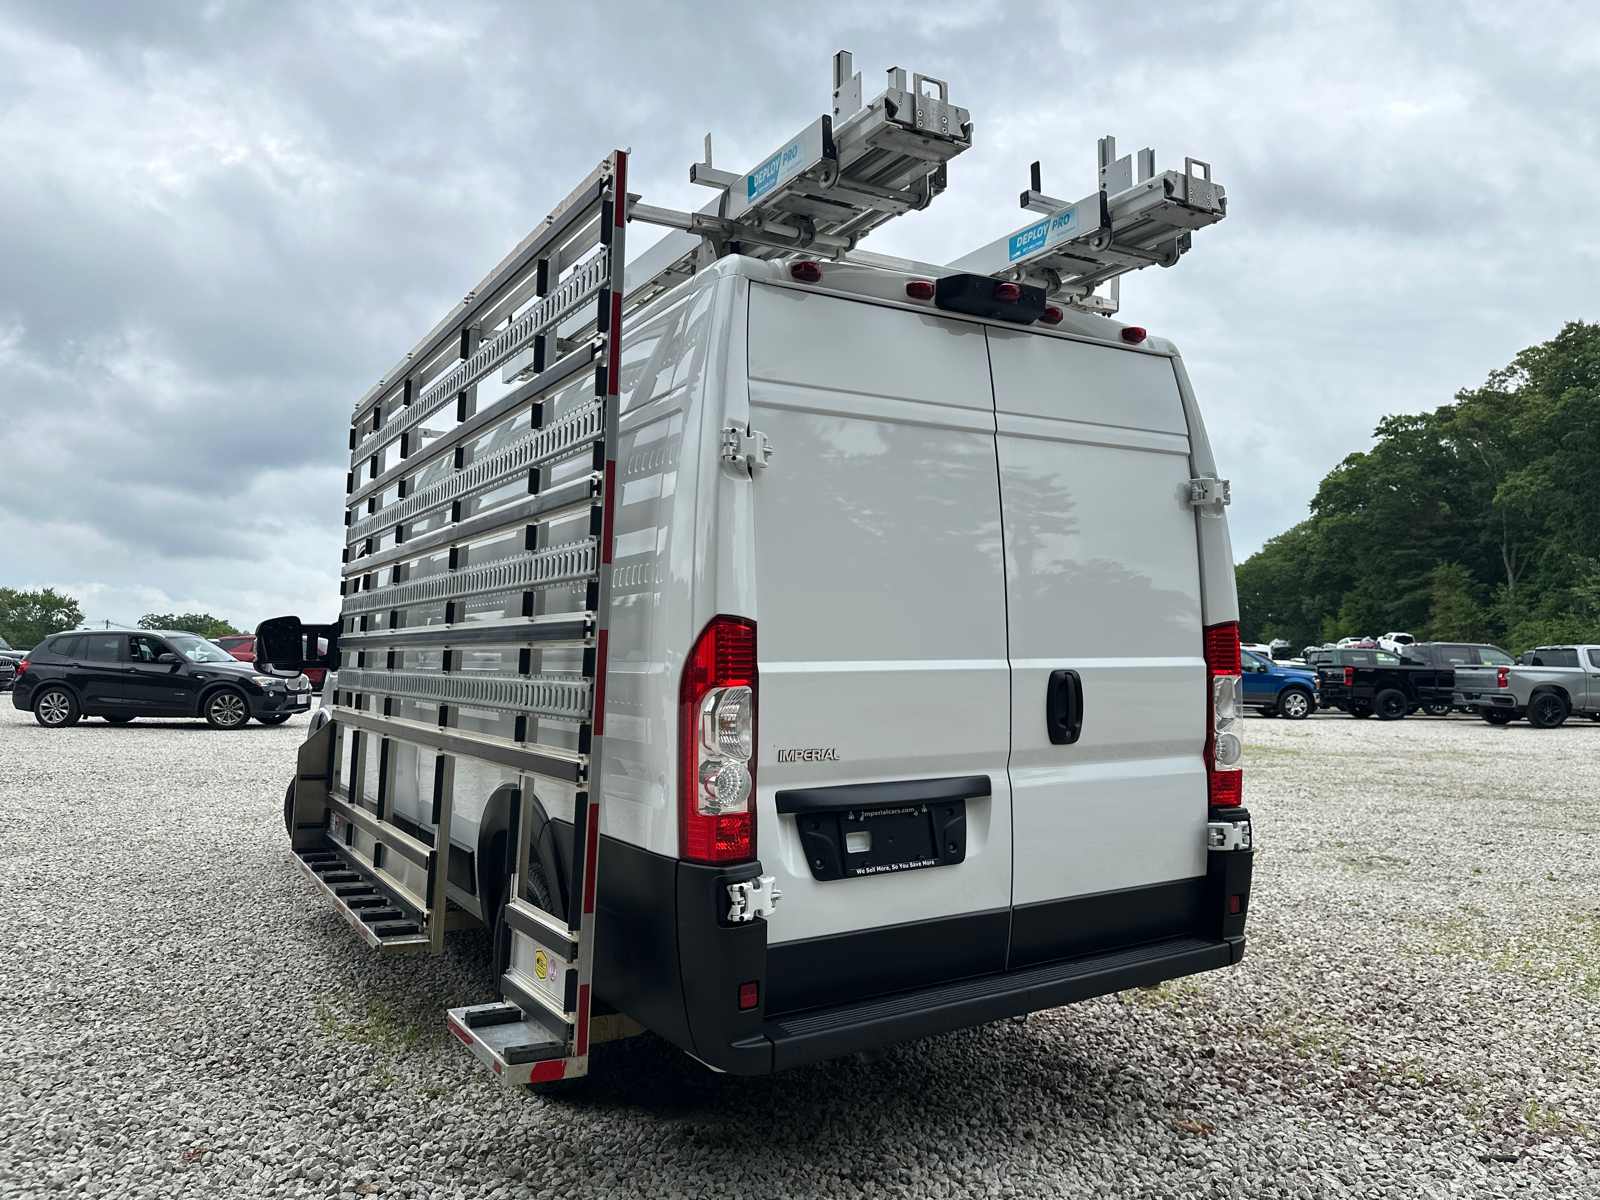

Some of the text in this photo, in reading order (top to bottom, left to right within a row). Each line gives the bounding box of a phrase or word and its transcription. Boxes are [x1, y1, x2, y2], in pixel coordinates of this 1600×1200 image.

[754, 158, 780, 187] DEPLOY
[782, 145, 798, 166] PRO
[1016, 223, 1049, 248] DEPLOY
[1052, 214, 1070, 231] PRO
[778, 748, 840, 762] IMPERIAL
[861, 807, 915, 817] Imperialcars.com
